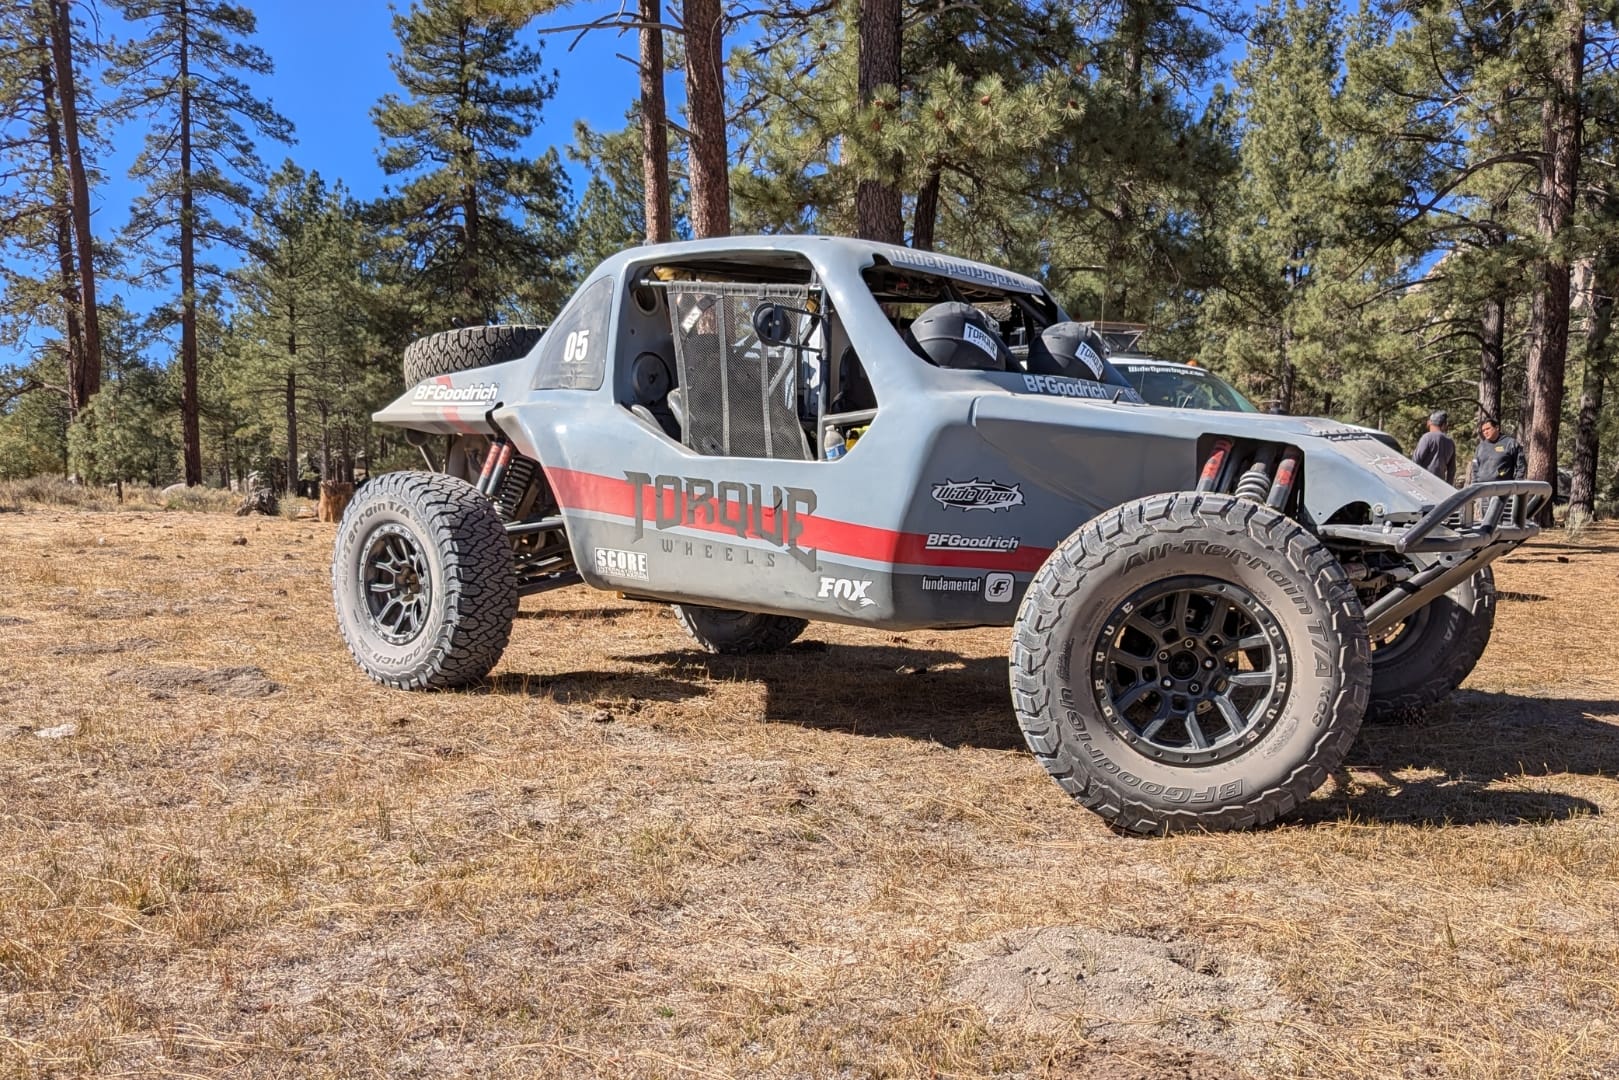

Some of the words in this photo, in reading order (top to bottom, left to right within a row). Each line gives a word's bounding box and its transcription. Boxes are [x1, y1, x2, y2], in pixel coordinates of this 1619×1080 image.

[563, 329, 590, 362] 05
[413, 382, 499, 401] BFGoodrich
[1022, 373, 1109, 399] BFGoodrich
[623, 470, 819, 573] TORQUE
[660, 538, 776, 568] WHEELS
[926, 533, 1019, 549] BFGoodrich
[596, 549, 647, 572] SCORE
[817, 576, 874, 605] FOX
[922, 575, 981, 592] fundamental
[1121, 539, 1313, 616] All-Terrain
[1307, 619, 1333, 679] T/A
[1058, 686, 1244, 804] BFGoodrich
